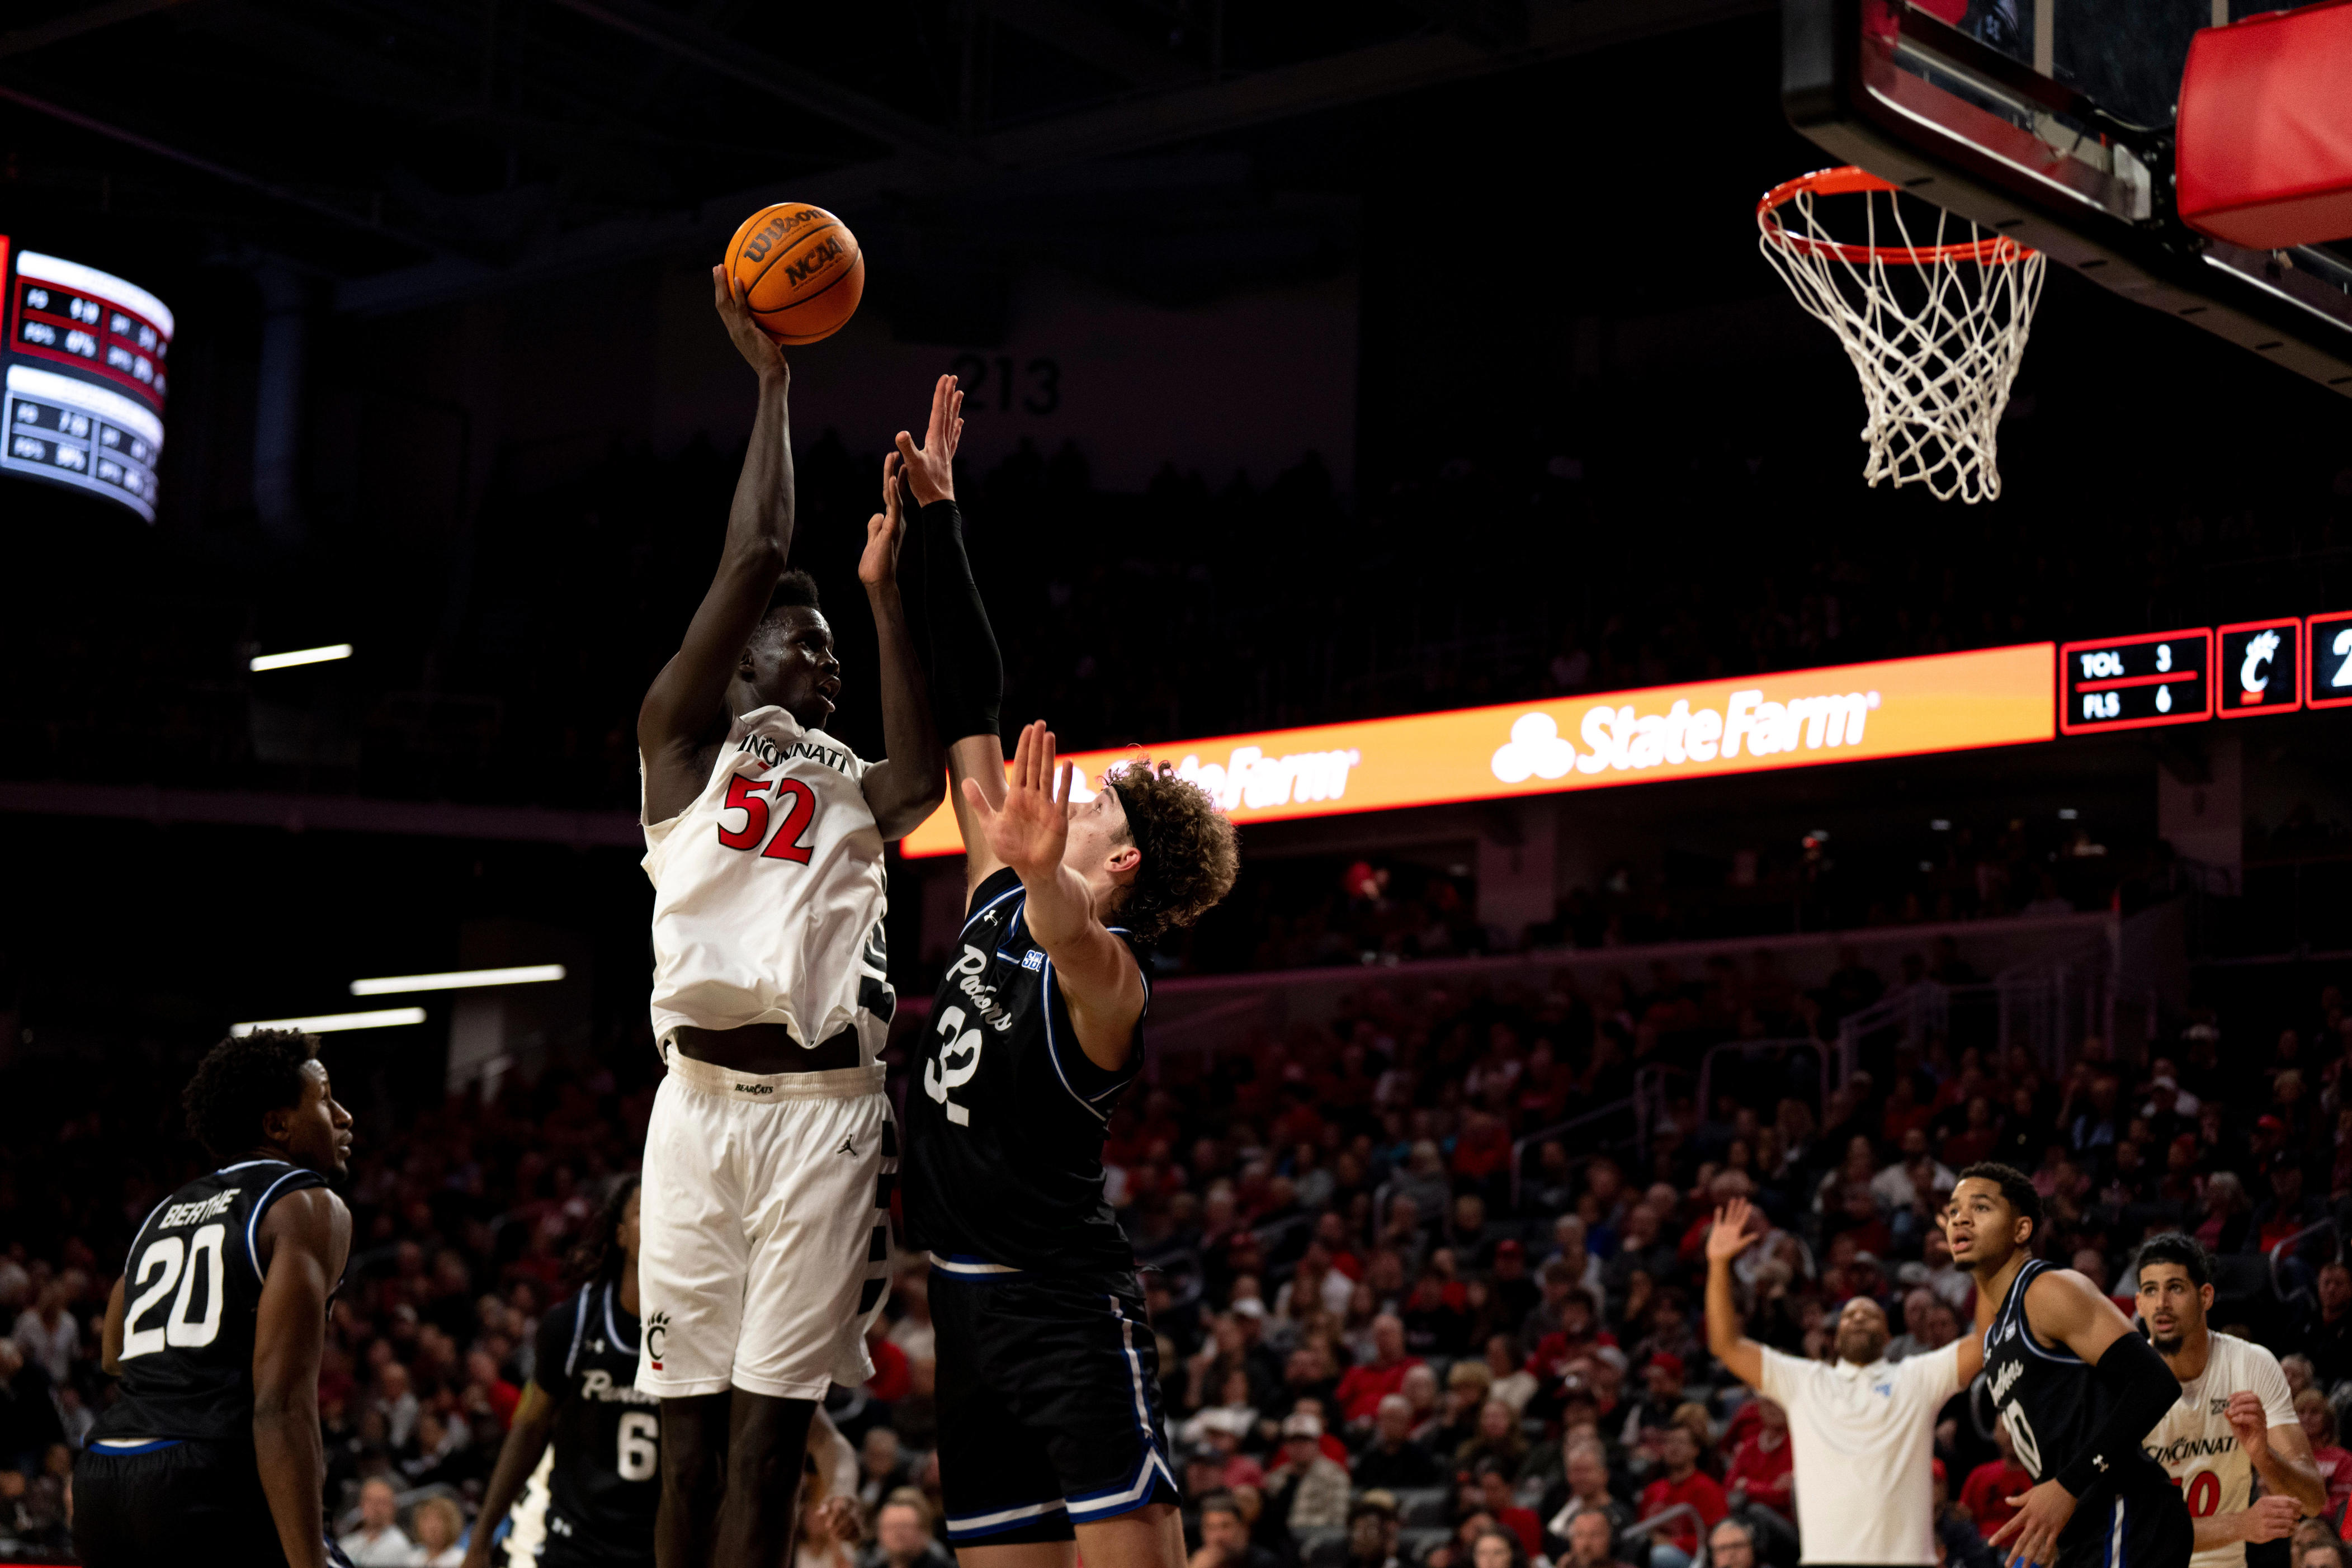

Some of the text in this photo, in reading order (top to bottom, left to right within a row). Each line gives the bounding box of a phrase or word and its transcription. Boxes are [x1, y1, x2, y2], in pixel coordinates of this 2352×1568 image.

[743, 209, 827, 263] Wilson
[785, 235, 843, 287] NCAA
[952, 353, 1058, 414] 213
[2080, 644, 2172, 678] TOL 3
[2083, 692, 2120, 719] FLS
[717, 772, 814, 866] 52
[735, 1084, 773, 1094] BEARCATS
[924, 1005, 983, 1127] 32
[158, 1188, 241, 1230] BERTHE
[118, 1224, 225, 1361] 20
[617, 1410, 659, 1482] 6
[2170, 1477, 2221, 1517] 0
